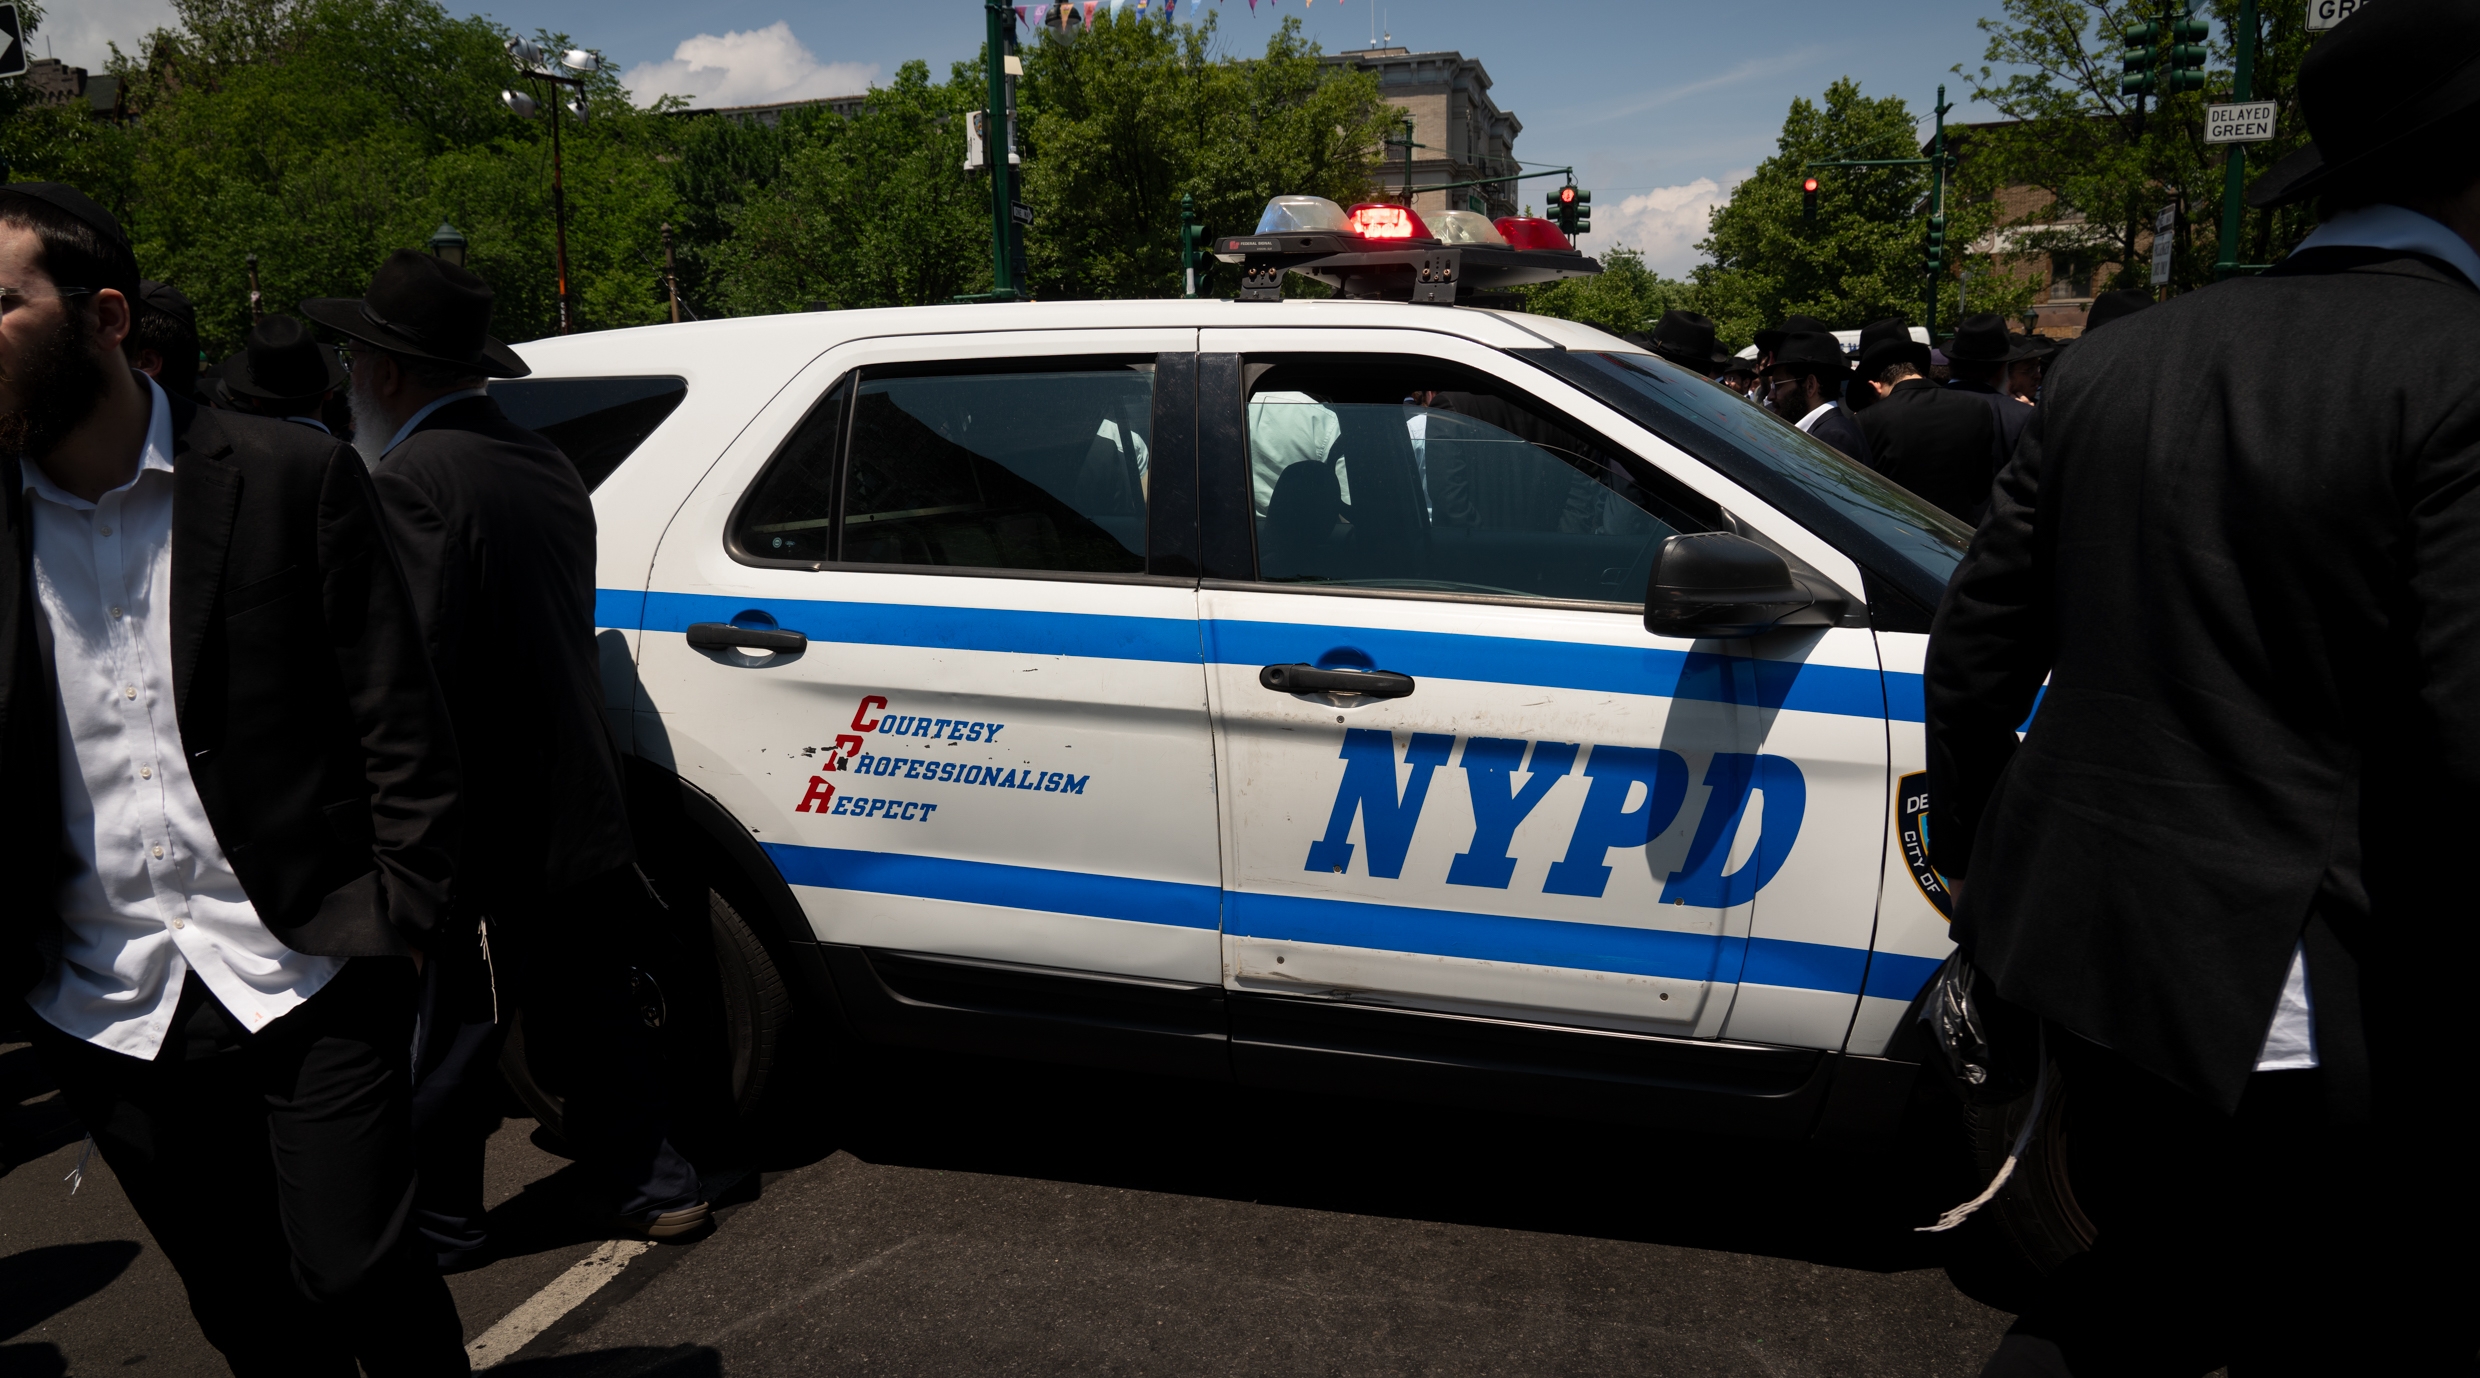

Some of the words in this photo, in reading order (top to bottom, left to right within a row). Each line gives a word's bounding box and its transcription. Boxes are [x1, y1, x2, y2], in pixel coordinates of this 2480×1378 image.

[2212, 107, 2270, 123] DELAYED
[2212, 122, 2268, 137] GREEN
[850, 695, 1004, 744] COURTESY
[822, 734, 1090, 795] PROFESSIONALISM
[795, 775, 938, 823] RESPECT
[1304, 728, 1807, 909] NYPD
[1904, 830, 1925, 867] CITY
[1920, 872, 1941, 893] OF
